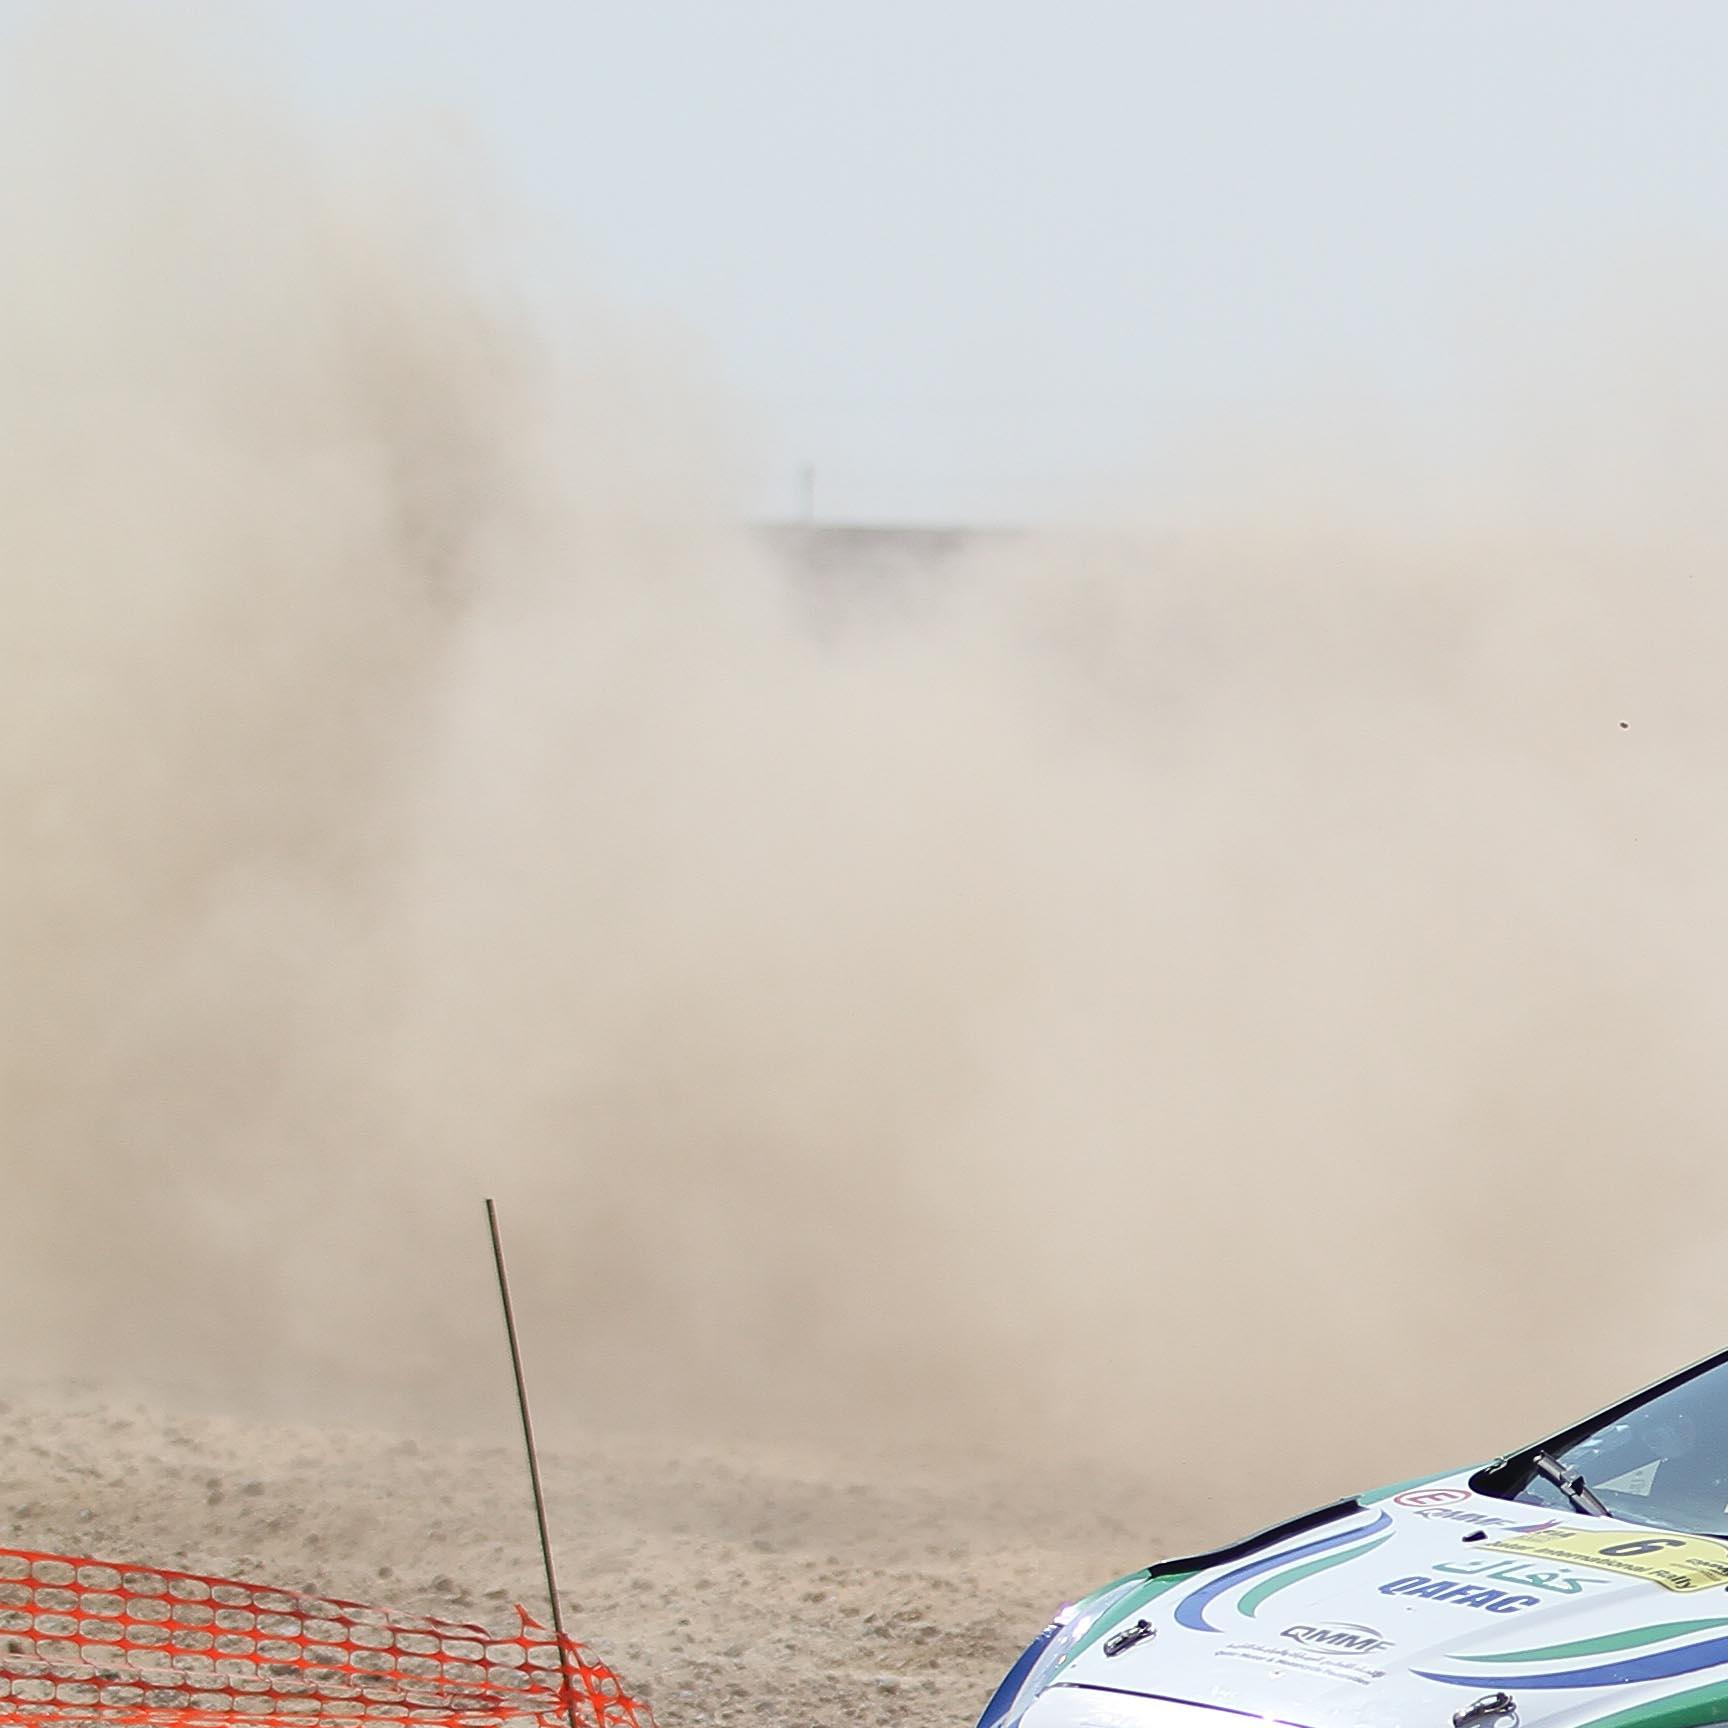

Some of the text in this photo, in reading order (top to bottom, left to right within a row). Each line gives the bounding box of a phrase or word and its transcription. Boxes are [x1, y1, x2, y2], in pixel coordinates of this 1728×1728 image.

[1599, 1538, 1687, 1558] 6
[1650, 1569, 1700, 1590] Rally
[1377, 1575, 1541, 1614] QAFAC
[1279, 1625, 1397, 1654] QMMF
